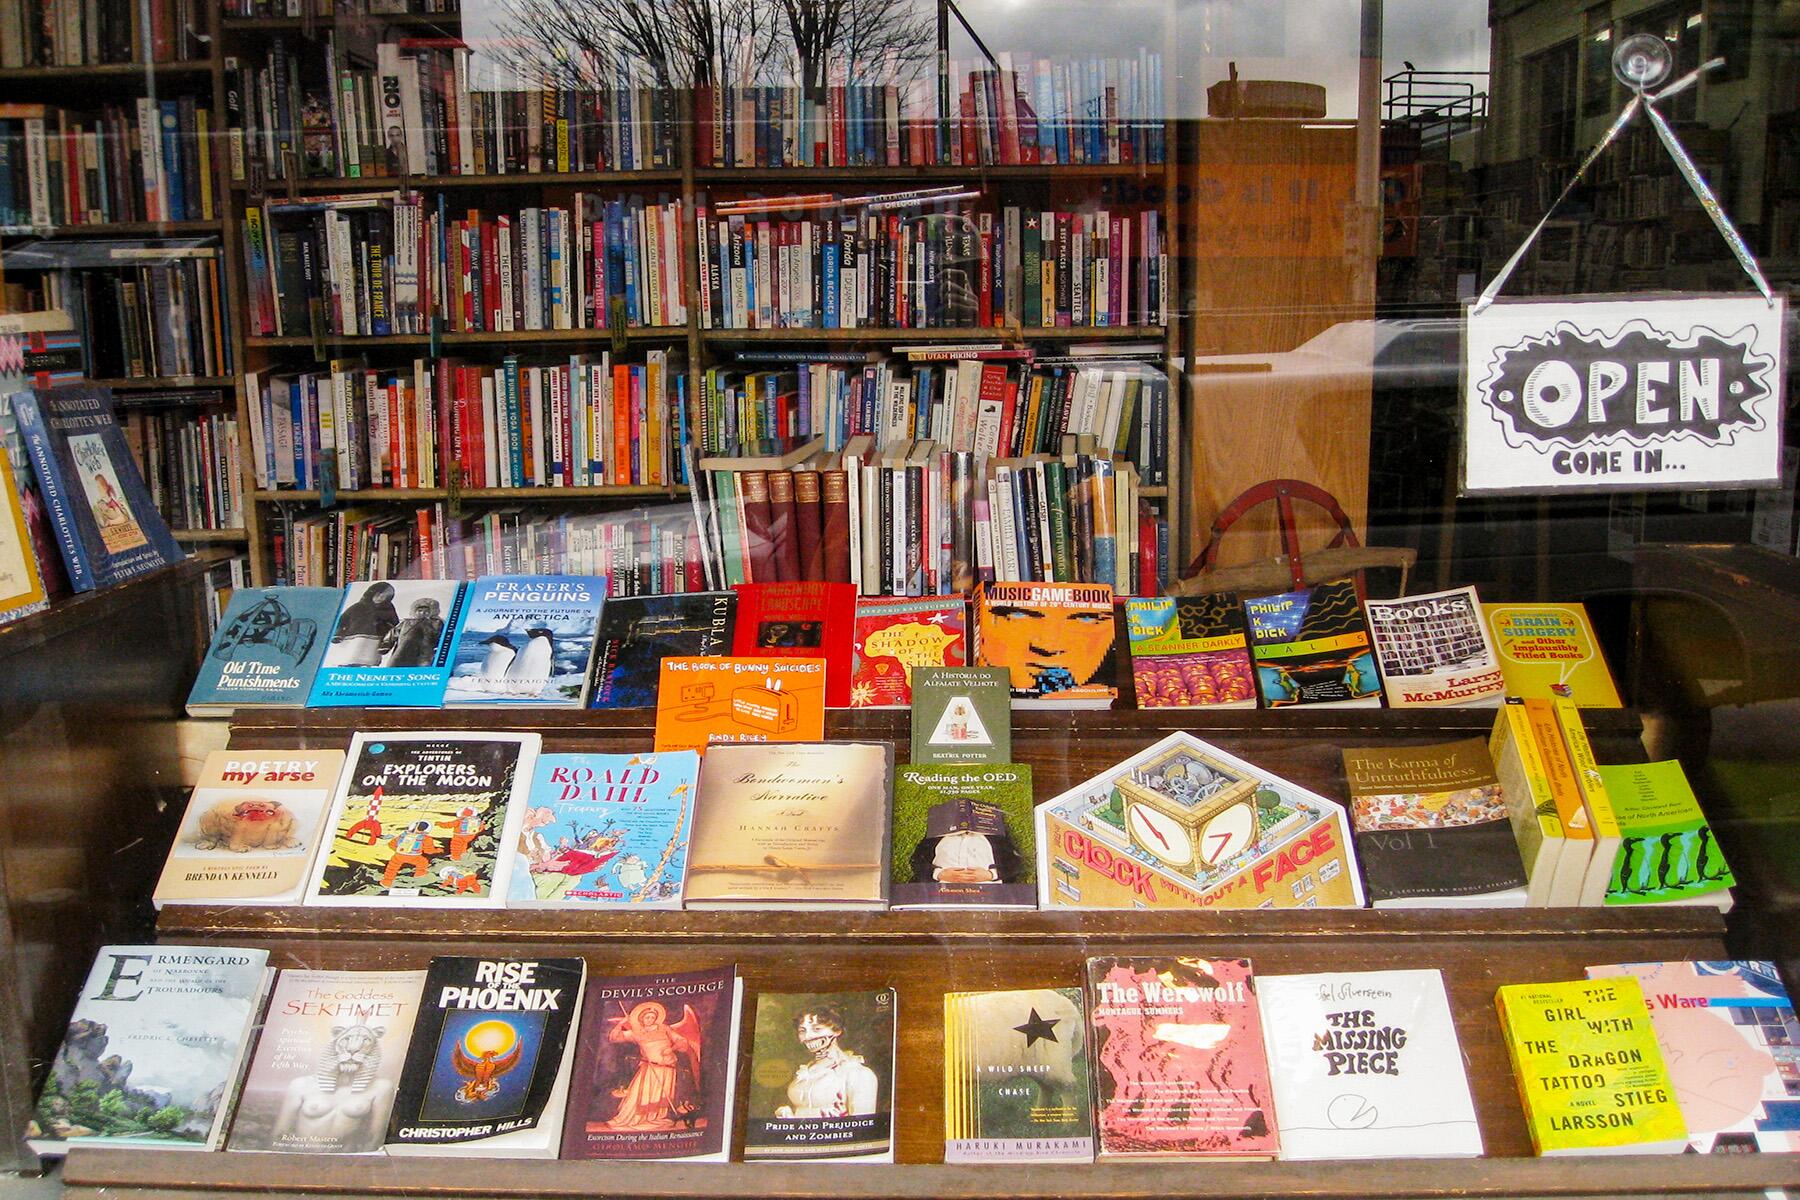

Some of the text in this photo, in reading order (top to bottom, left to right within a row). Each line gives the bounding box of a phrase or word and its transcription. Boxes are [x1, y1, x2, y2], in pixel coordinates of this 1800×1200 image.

[228, 90, 238, 111] Golf
[733, 233, 742, 266] Arizona
[843, 233, 854, 266] Florida
[371, 245, 384, 318] THE TOUR DE FRANCE
[710, 264, 719, 290] ALASKA
[827, 280, 835, 315] BEACHES
[1073, 282, 1082, 314] SEATTLE
[345, 379, 353, 423] MARATHON
[1523, 358, 1720, 428] OPEN
[509, 412, 518, 451] YOGA BOOK
[1552, 451, 1622, 475] COME
[495, 583, 585, 592] FRASER'S
[484, 592, 591, 602] PENGUINS
[1013, 600, 1038, 608] HISTORY
[1063, 601, 1090, 609] CENTURY
[1129, 601, 1173, 612] PHILIP
[1250, 601, 1294, 614] PHILIP
[1371, 599, 1467, 621] Books
[710, 597, 729, 646] KUBLA
[1512, 617, 1561, 627] BRAIN
[1132, 626, 1164, 636] DICK
[1255, 627, 1288, 638] DICK
[1502, 627, 1577, 637] SURGERY
[871, 636, 945, 649] SHADOW
[1147, 642, 1201, 651] SCANNER
[1202, 637, 1241, 649] DARKLY
[1513, 644, 1578, 653] Implausibly
[916, 651, 940, 659] THE
[223, 661, 281, 674] Old Time
[667, 661, 821, 674] THE BOOK OF BUNNY SUICIDES
[217, 675, 300, 689] Punishments
[1447, 670, 1502, 688] Larry
[1402, 680, 1505, 702] McMurtry
[708, 733, 767, 742] ANDY RILEY
[225, 761, 320, 773] POETRY
[383, 764, 476, 775] EXPLORERS
[1352, 754, 1457, 770] The Karma of
[221, 772, 315, 785] my arse
[362, 775, 492, 787] ON THE MOON
[550, 767, 660, 785] ROALD
[733, 773, 844, 785] Bondwoman's
[903, 772, 1017, 785] Reading the OED
[1355, 766, 1476, 783] Untruthfulness
[559, 785, 650, 803] DAHL
[751, 790, 828, 801] Narrative
[553, 802, 619, 819] Treasury
[1658, 807, 1693, 817] American
[1369, 833, 1439, 850] Vol 1
[1063, 822, 1336, 908] CLOCK WITHOUT A FACE
[185, 871, 278, 881] BRENDAN KENNELLY
[475, 961, 538, 984] RISE
[144, 986, 224, 994] TROUBADOURS
[307, 988, 394, 1000] The Goddess
[601, 980, 725, 999] DEVIL'S SCOURGE
[1096, 982, 1139, 1003] The
[1338, 982, 1392, 1000] Silverstein
[1583, 987, 1618, 1003] THE
[438, 986, 562, 1010] PHOENIX
[1656, 993, 1709, 1010] Ware
[282, 1001, 408, 1017] SEKHMET
[1098, 1007, 1184, 1015] MONTAGUE SUMMERS
[1545, 1007, 1586, 1022] GIRL
[1326, 1010, 1376, 1028] THE
[1586, 1017, 1634, 1034] WITH
[1312, 1026, 1407, 1051] MISSING
[1523, 1040, 1559, 1055] THE
[1323, 1051, 1399, 1076] PIECE
[1568, 1048, 1643, 1069] DRAGON
[976, 1065, 982, 1073] A
[1020, 1065, 1051, 1073] SHEEP
[1540, 1074, 1606, 1091] TATTOO
[998, 1088, 1030, 1096] CHASE
[1614, 1089, 1668, 1108] STIEG
[399, 1118, 533, 1138] CHRISTOPHER HILLS
[822, 1120, 874, 1129] PREJUDICE
[1550, 1112, 1634, 1131] LARSSON
[281, 1134, 307, 1142] Robert
[587, 1133, 615, 1141] Exorcism
[616, 1133, 638, 1141] During
[649, 1132, 668, 1140] Italian
[669, 1130, 703, 1139] Renaissance
[785, 1131, 853, 1141] AND ZOMBIES
[956, 1141, 1087, 1150] HARUKI MURAKAMI
